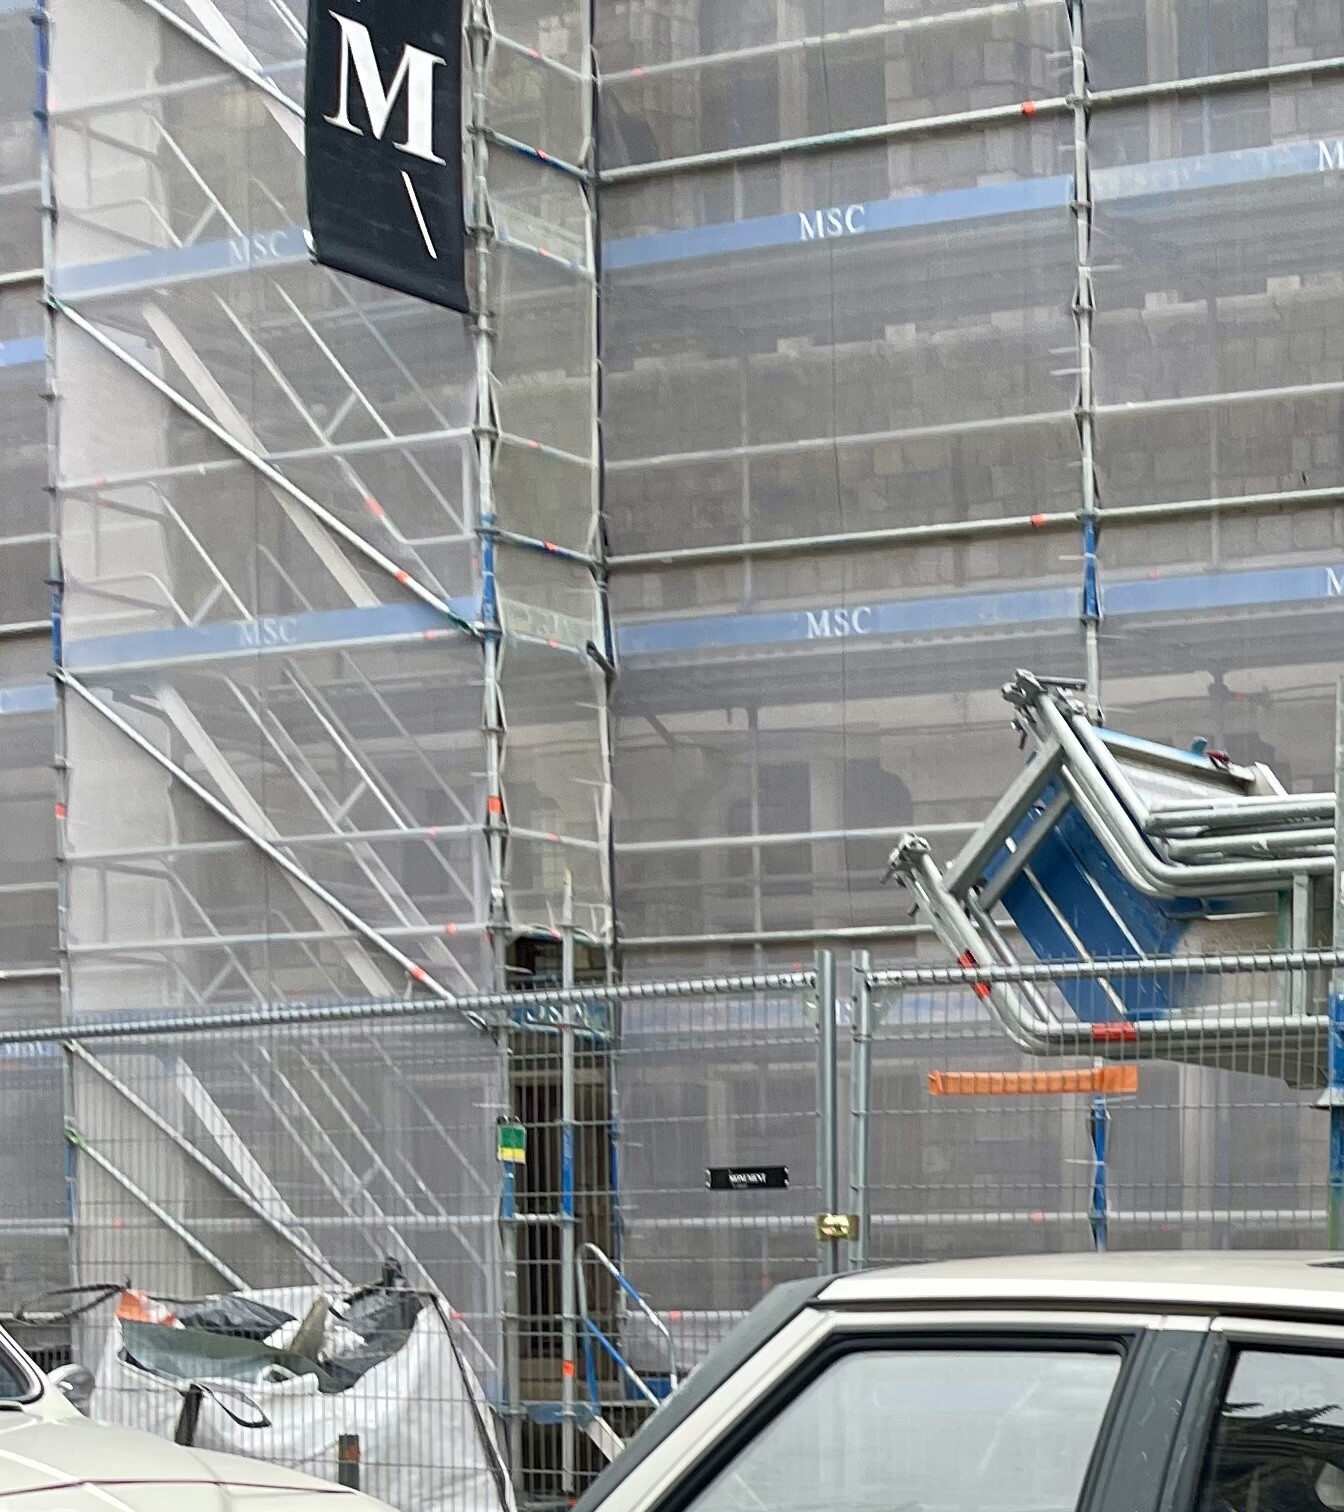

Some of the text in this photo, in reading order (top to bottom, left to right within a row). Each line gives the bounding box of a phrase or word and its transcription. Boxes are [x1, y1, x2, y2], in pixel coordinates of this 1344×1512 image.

[322, 9, 447, 167] M
[800, 205, 866, 241] MSC
[806, 605, 873, 639] MSC
